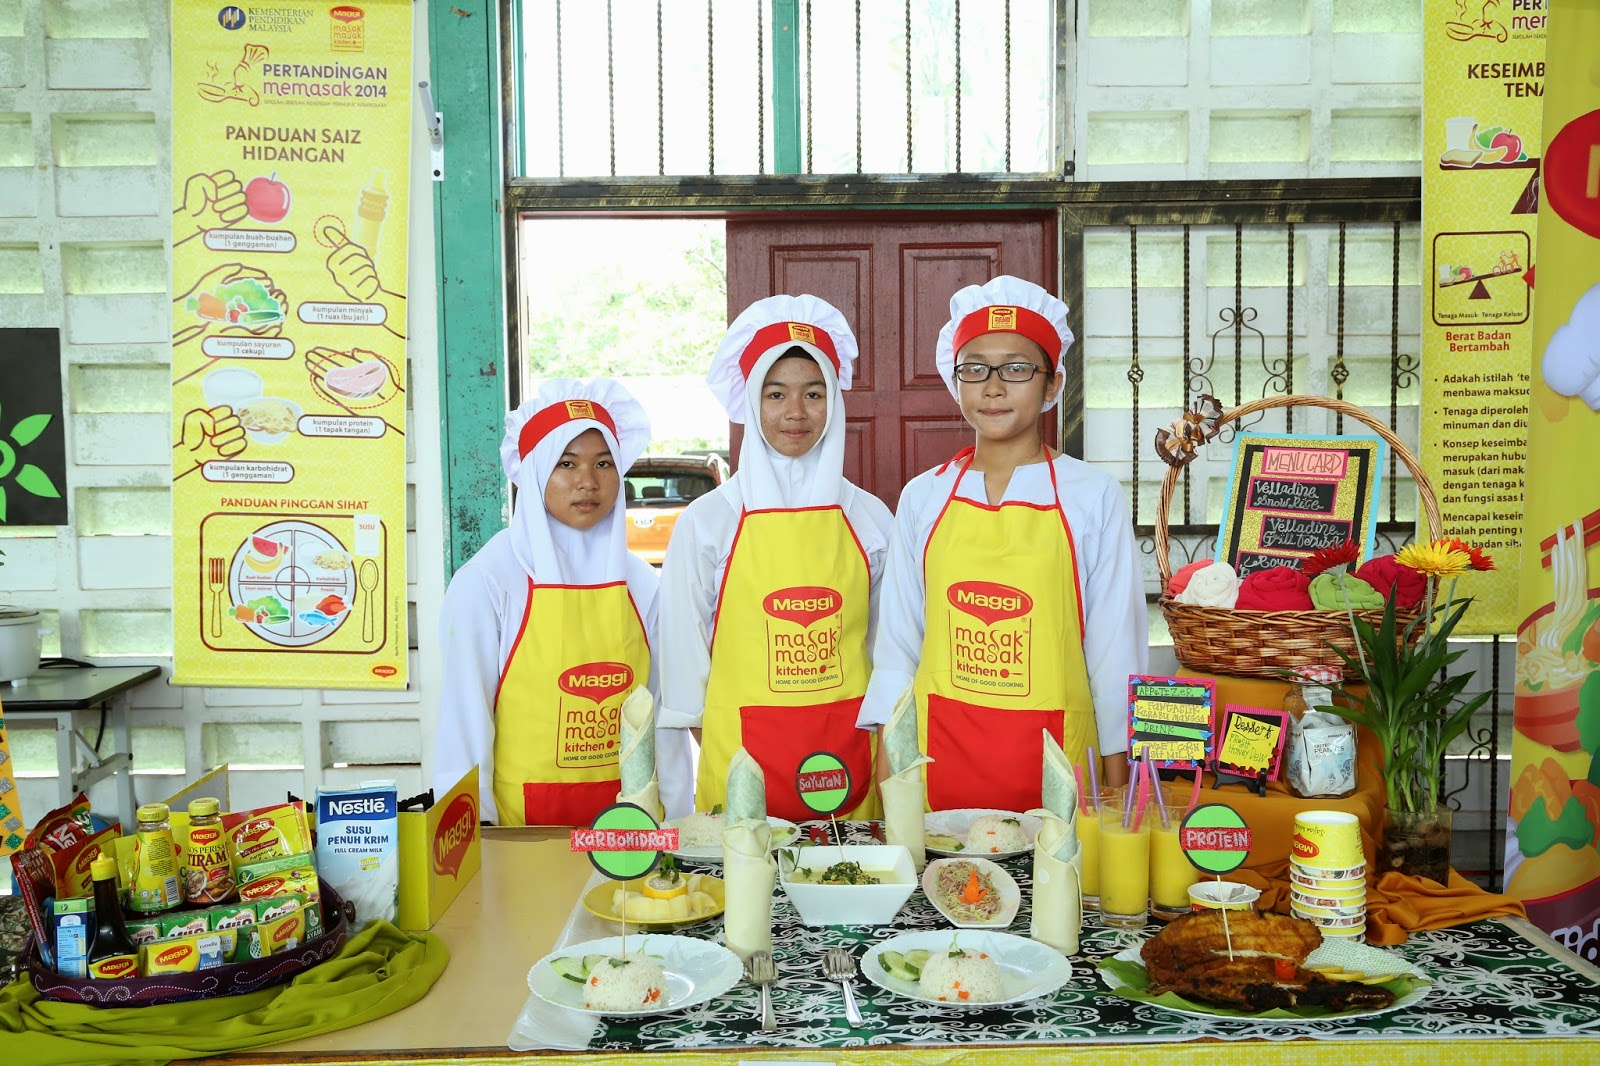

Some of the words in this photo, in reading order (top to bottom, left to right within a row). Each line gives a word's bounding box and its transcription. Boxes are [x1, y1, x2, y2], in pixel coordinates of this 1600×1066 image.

[248, 8, 314, 17] KEMENTERIAN
[333, 10, 360, 18] Maggi
[249, 16, 306, 25] PENDIDIKAN
[249, 24, 292, 33] MALAYSIA
[263, 62, 387, 80] PERTANDINGAN
[263, 81, 352, 97] memasak
[355, 84, 387, 98] 2014
[226, 125, 316, 143] PANDUAN
[321, 128, 361, 145] SAIZ
[243, 145, 344, 163] HIDANGAN
[208, 232, 244, 243] kumpulan
[245, 233, 293, 243] buah-buahan
[232, 241, 277, 250] genggaman)
[312, 305, 348, 314] kumpulan
[348, 307, 374, 315] minyak
[1446, 331, 1475, 341] Berat
[1477, 330, 1511, 340] Badan
[216, 340, 253, 350] kumpulan
[254, 341, 281, 351] sayuran
[1449, 341, 1510, 352] Bertambah
[1443, 374, 1480, 383] Adakah
[1483, 373, 1513, 382] istilah
[1443, 387, 1491, 397] menbawa
[1443, 407, 1478, 417] Tenaga
[1480, 405, 1528, 417] diperoleh
[312, 418, 348, 428] kumpulan
[348, 419, 373, 429] protein
[1443, 420, 1490, 430] minuman
[1492, 419, 1511, 428] dan
[1443, 439, 1479, 450] Konsep
[1267, 451, 1308, 472] MENU
[1306, 453, 1342, 474] CARD
[1443, 452, 1499, 464] merupakan
[209, 463, 245, 473] kumpulan
[246, 464, 288, 473] karbohidrat
[1443, 466, 1475, 476] masuk
[1477, 466, 1501, 477] (dari
[1443, 481, 1480, 491] dengan
[1482, 481, 1517, 491] tenaga
[220, 498, 278, 508] PANDUAN
[280, 499, 335, 509] PINGGAN
[336, 500, 369, 510] SIHAT
[1443, 494, 1461, 503] dan
[1463, 493, 1495, 504] fungsi
[1443, 512, 1490, 523] Mencapai
[1443, 527, 1476, 536] adalah
[1478, 525, 1517, 537] penting
[1472, 539, 1503, 549] badan
[772, 594, 834, 612] Maggi
[957, 589, 1022, 611] Maggi
[776, 665, 817, 676] kitchen
[957, 659, 998, 677] kitchen
[569, 671, 627, 688] Maggi
[817, 674, 839, 683] COOKING
[1143, 722, 1175, 734] DRINK
[565, 741, 604, 753] kitchen
[345, 825, 372, 834] SUSU
[439, 806, 471, 863] Maggi
[192, 831, 217, 840] Maggi
[327, 836, 360, 846] PENUH
[364, 835, 389, 844] KRIM
[1186, 830, 1248, 848] PROTEIN
[246, 879, 280, 897] Maggi
[276, 920, 297, 939] Maggi
[306, 928, 322, 940] AYAM
[159, 948, 188, 963] Maggi
[102, 961, 130, 972] Maggi
